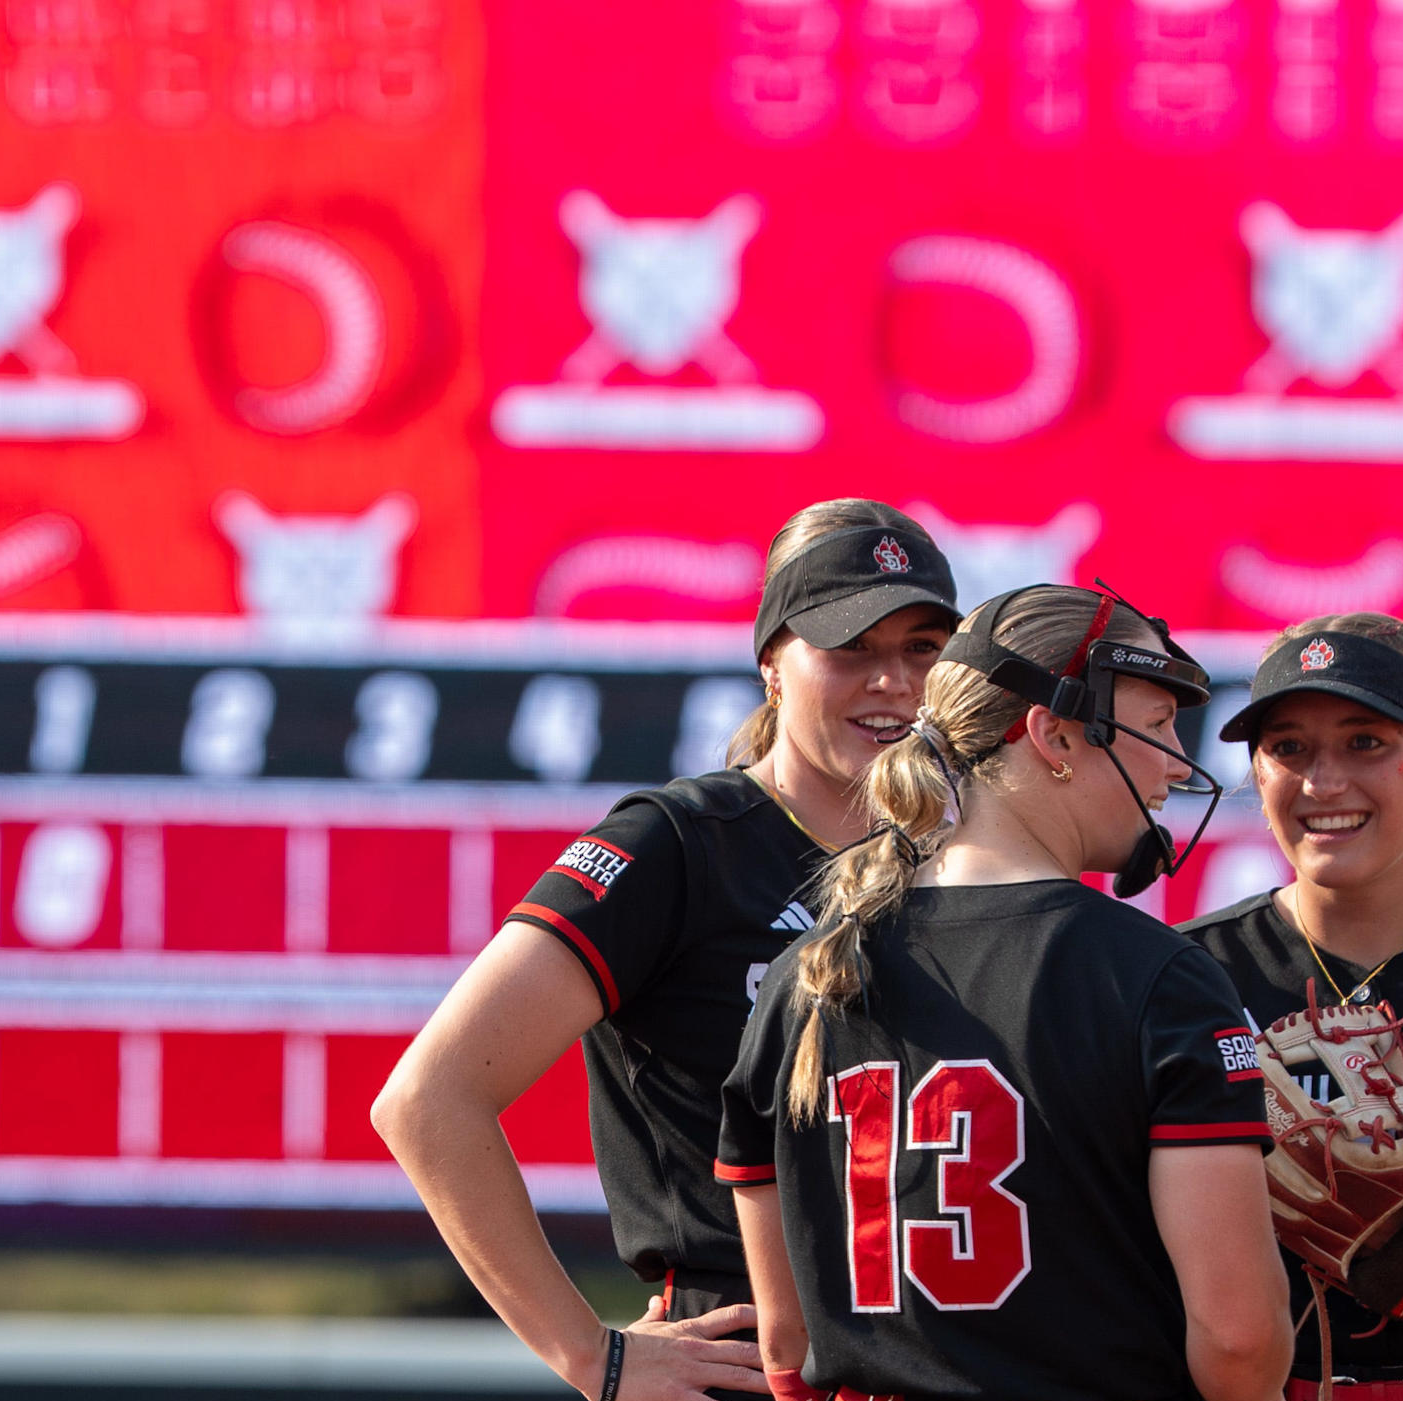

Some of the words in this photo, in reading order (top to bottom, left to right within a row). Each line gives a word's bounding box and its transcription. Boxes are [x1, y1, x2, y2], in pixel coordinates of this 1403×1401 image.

[1127, 653, 1168, 668] RIP-IT
[29, 666, 95, 774] 1
[181, 668, 275, 778] 2
[346, 670, 439, 781] 3
[508, 673, 601, 783] 4
[13, 824, 112, 946] 0
[565, 841, 629, 875] SOUTH
[827, 1059, 1031, 1313] 13
